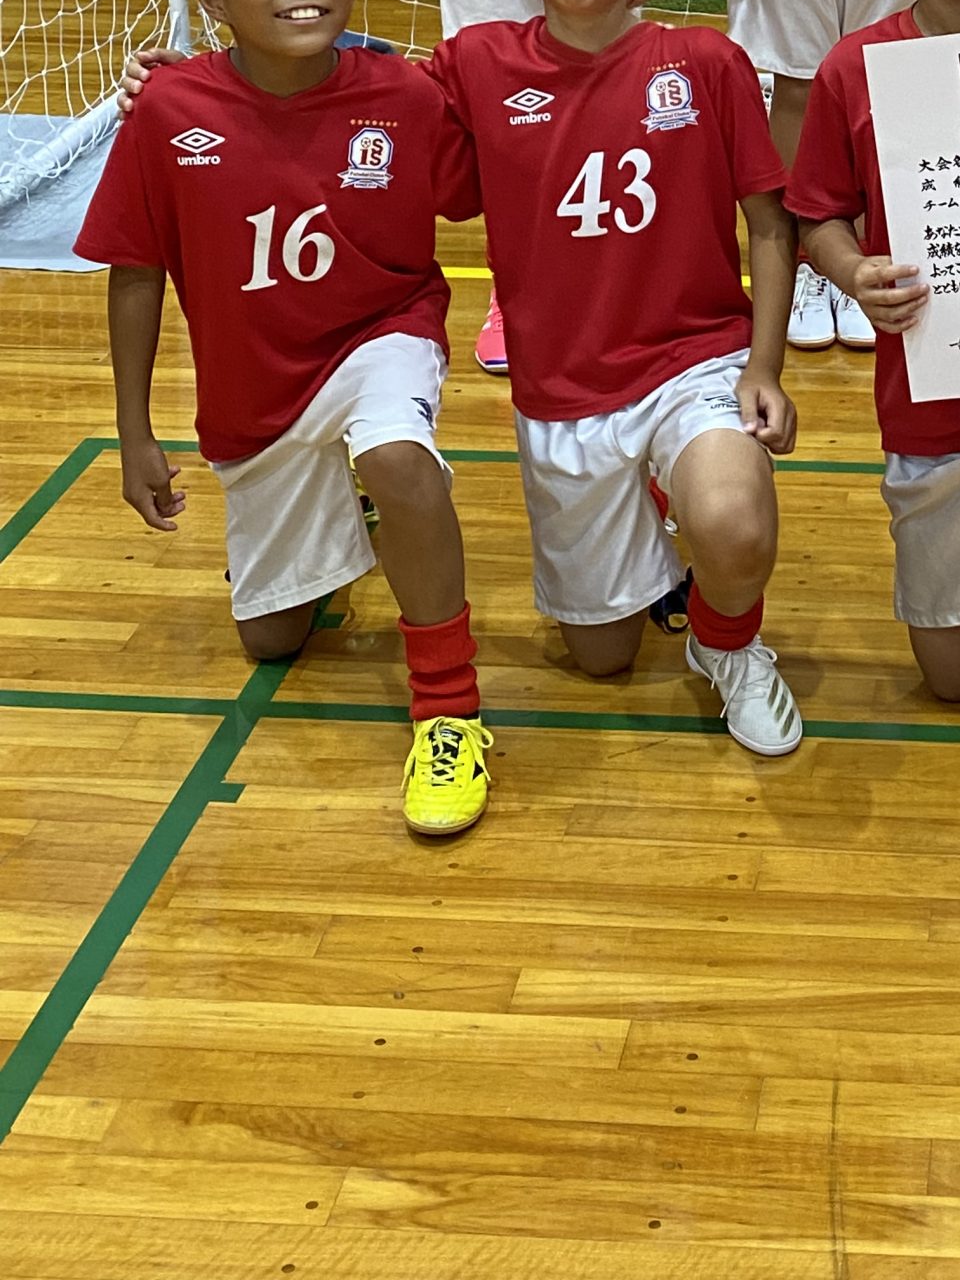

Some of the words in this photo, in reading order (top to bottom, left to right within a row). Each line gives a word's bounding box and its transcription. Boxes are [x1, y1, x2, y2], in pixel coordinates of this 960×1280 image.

[510, 112, 551, 125] umbro
[177, 154, 221, 166] umbro
[556, 148, 657, 237] 43
[241, 205, 335, 291] 16
